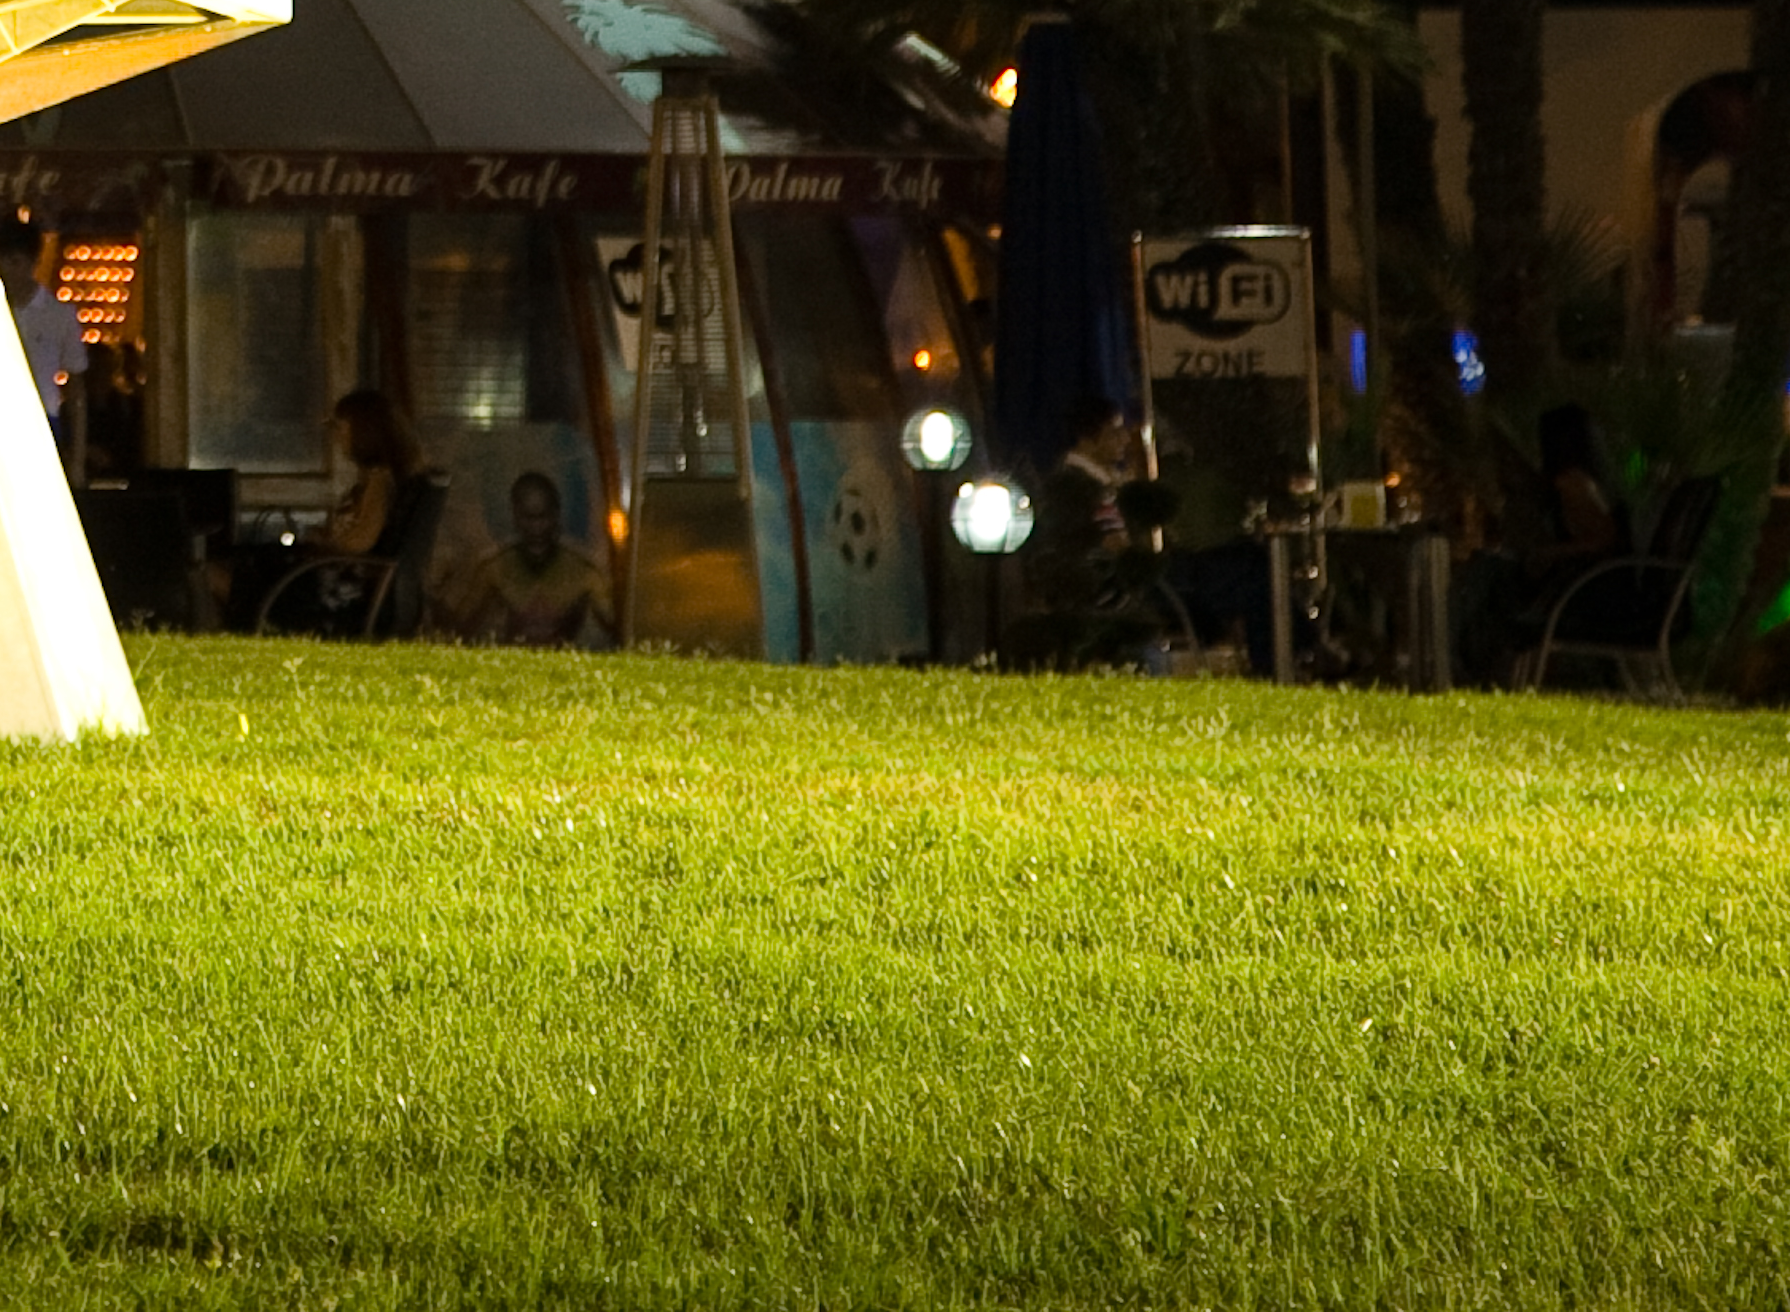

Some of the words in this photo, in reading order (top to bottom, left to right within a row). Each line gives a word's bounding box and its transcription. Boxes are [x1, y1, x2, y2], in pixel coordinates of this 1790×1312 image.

[241, 153, 423, 205] Palma
[462, 155, 579, 211] Kafe
[1174, 348, 1266, 379] ZONE
